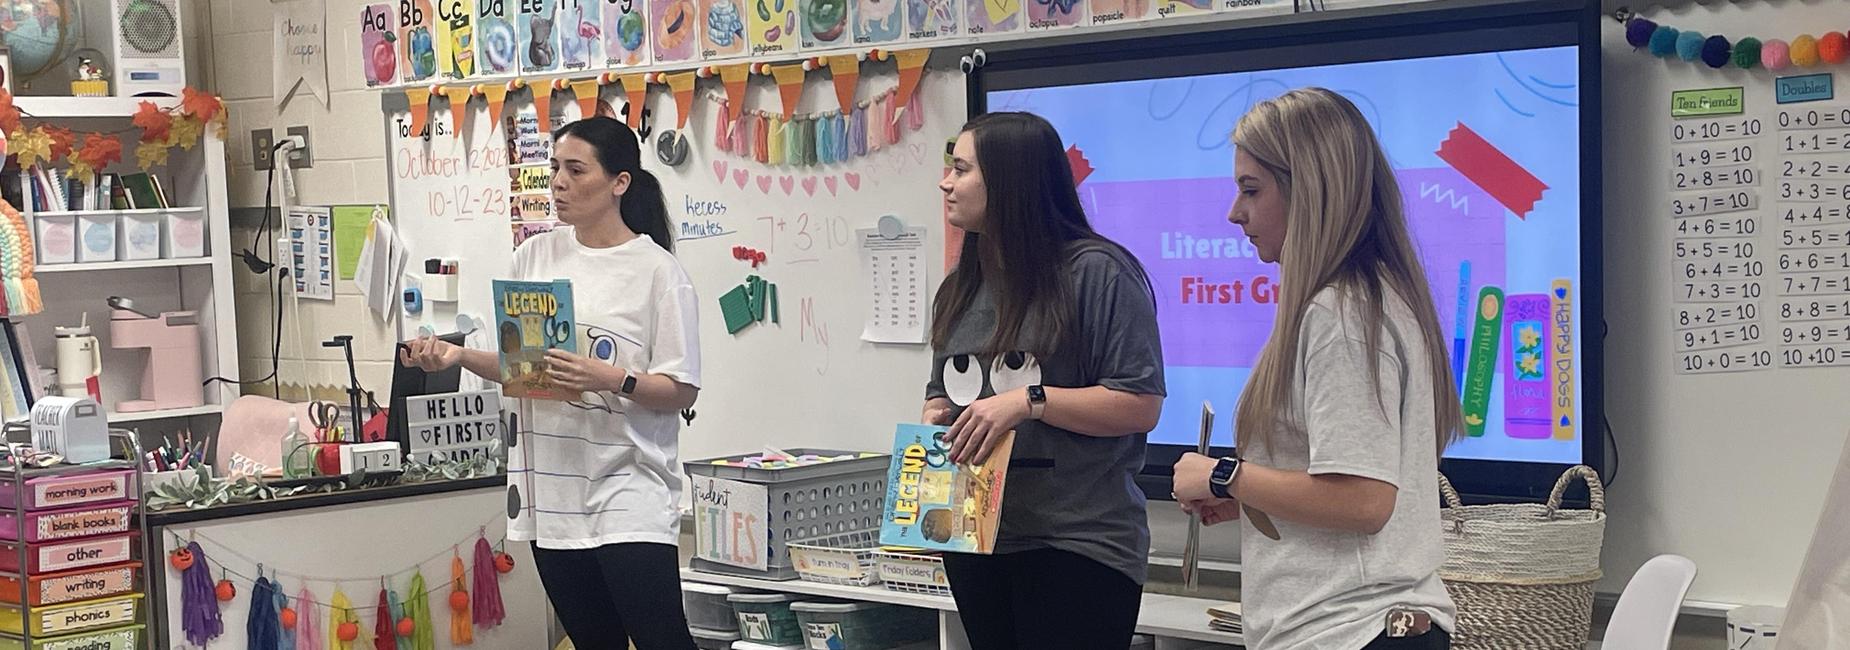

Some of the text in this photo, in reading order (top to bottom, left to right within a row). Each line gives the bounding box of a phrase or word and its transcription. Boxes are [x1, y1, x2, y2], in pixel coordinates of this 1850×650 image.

[362, 5, 386, 32] Aa
[400, 0, 423, 27] Bb
[438, 0, 463, 21] Cc
[1093, 11, 1124, 25] popsicle
[1158, 4, 1176, 18] quilt
[909, 30, 937, 39] markers
[968, 26, 984, 34] note
[1029, 20, 1059, 29] octopus
[752, 44, 783, 56] jellybeans
[1782, 82, 1827, 96] Doubles
[1677, 96, 1697, 109] Ten
[1778, 111, 1790, 128] 0
[1807, 110, 1819, 127] 0
[1841, 108, 1850, 125] 0
[396, 118, 430, 142] Toy
[1673, 124, 1685, 141] 0
[1700, 121, 1721, 139] 10
[1741, 118, 1761, 136] 10
[520, 139, 549, 149] Mornig
[1785, 135, 1794, 151] 1
[1811, 133, 1821, 151] 1
[397, 147, 460, 181] October
[1676, 151, 1685, 168] 1
[1700, 149, 1711, 166] 9
[1731, 145, 1753, 163] 10
[1675, 172, 1687, 189] 2
[1703, 170, 1713, 187] 8
[1733, 168, 1753, 185] 10
[1781, 182, 1792, 199] 3
[1809, 183, 1820, 200] 3
[521, 199, 551, 216] Writing
[1672, 199, 1684, 215] 3
[1698, 196, 1708, 212] 7
[1728, 191, 1749, 209] 10
[756, 216, 774, 254] 7
[795, 212, 813, 251] 3
[825, 215, 849, 250] 10
[1677, 219, 1687, 235] 4
[1704, 218, 1715, 235] 6
[1735, 217, 1755, 235] 10
[1161, 231, 1254, 260] Literac
[1676, 241, 1686, 258] 5
[1702, 241, 1713, 258] 5
[1733, 242, 1754, 259] 10
[1685, 263, 1696, 279] 6
[1712, 261, 1723, 278] 4
[1743, 260, 1763, 277] 10
[1181, 277, 1245, 305] First
[1684, 283, 1694, 299] 7
[1710, 283, 1721, 299] 3
[1741, 282, 1761, 299] 10
[503, 290, 558, 318] LEGEND
[1679, 310, 1690, 326] 8
[1705, 307, 1716, 324] 2
[1736, 303, 1756, 321] 10
[800, 296, 829, 376] My
[1684, 331, 1695, 348] 9
[1711, 329, 1721, 345] 1
[1739, 323, 1760, 342] 10
[1472, 323, 1492, 408] PHILOSOPHY
[1683, 354, 1703, 371] 10
[1719, 352, 1730, 369] 0
[1751, 350, 1771, 367] 10
[1556, 358, 1572, 409] DOGS
[426, 394, 484, 420] HELLO
[433, 421, 483, 446] FIRST
[46, 481, 118, 499] morning work
[693, 479, 732, 509] tudent
[894, 443, 928, 525] LEGEND
[52, 516, 116, 531] blank books
[697, 506, 758, 565] FILES
[67, 547, 103, 562] other
[65, 579, 106, 593] writing
[65, 609, 111, 626] phonics
